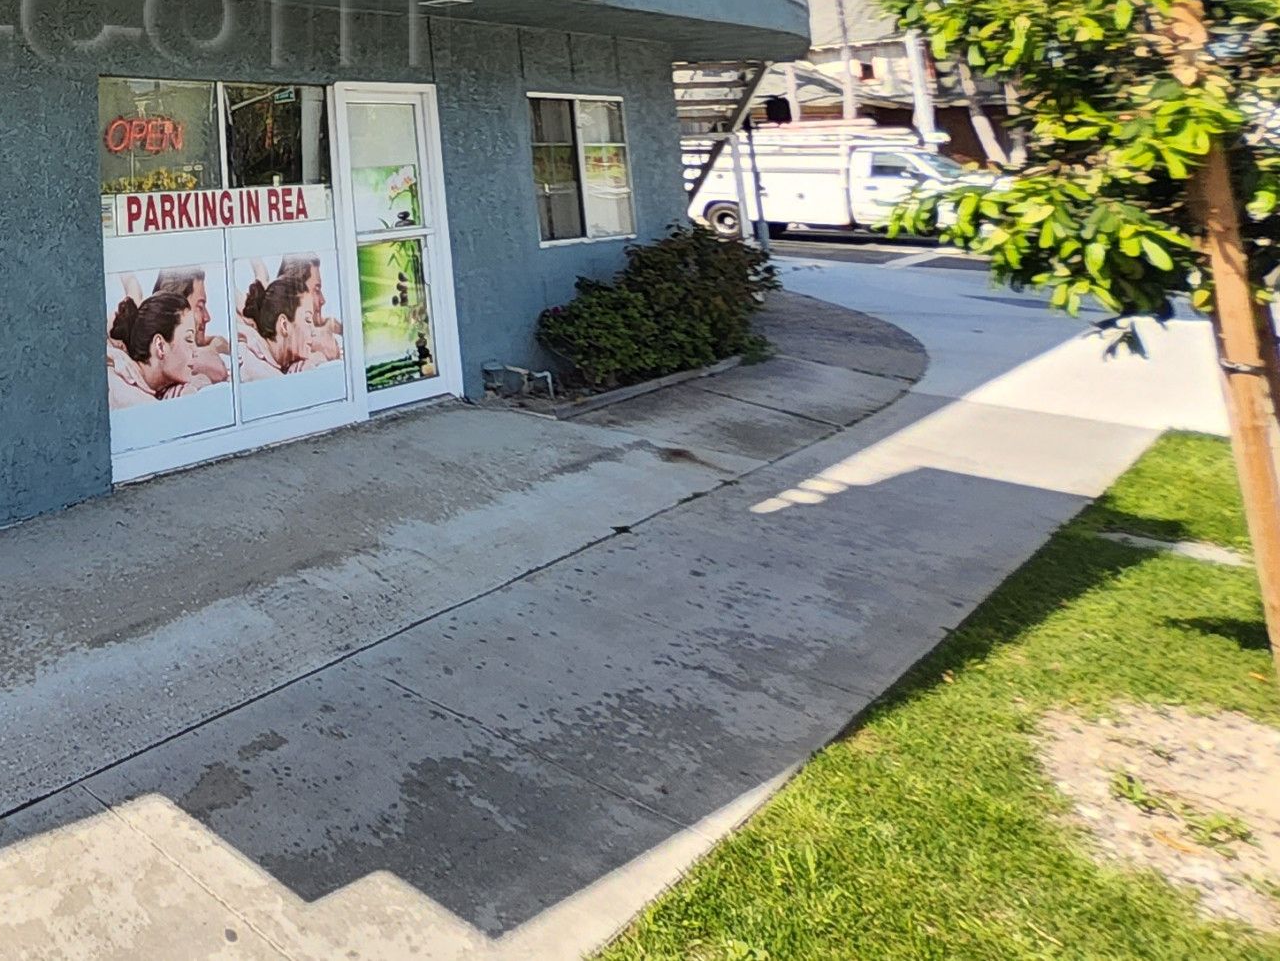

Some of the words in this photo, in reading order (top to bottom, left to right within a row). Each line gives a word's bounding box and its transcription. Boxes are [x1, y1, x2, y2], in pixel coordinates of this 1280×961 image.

[106, 117, 184, 153] OPEN
[126, 190, 234, 233] PARKING
[239, 189, 261, 224] IN
[267, 187, 309, 222] REA
